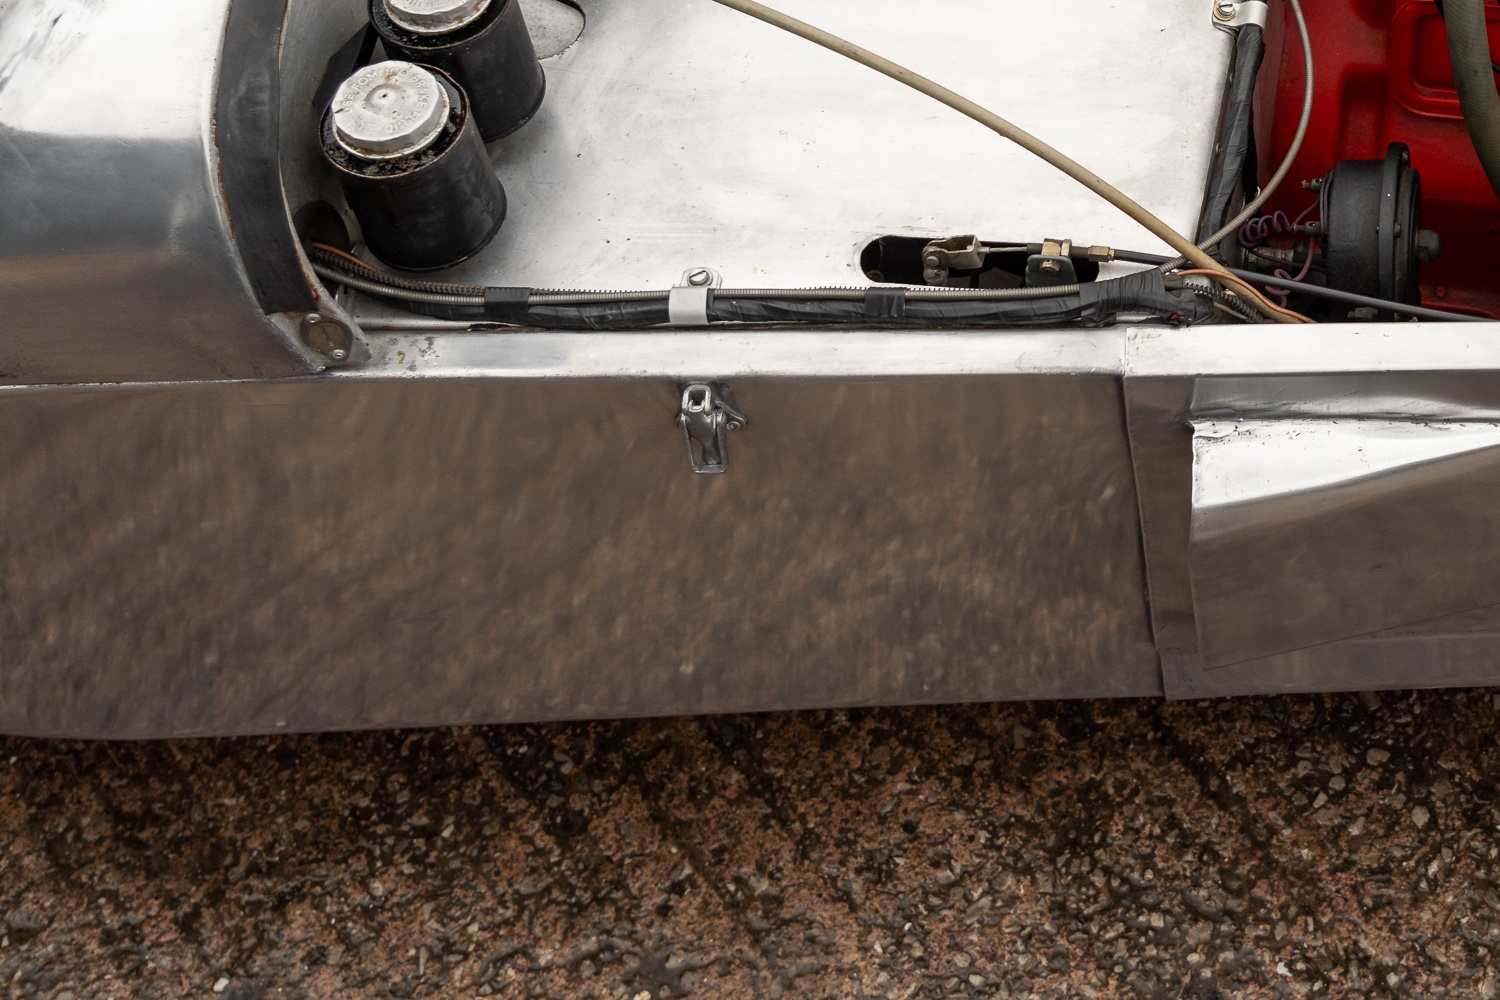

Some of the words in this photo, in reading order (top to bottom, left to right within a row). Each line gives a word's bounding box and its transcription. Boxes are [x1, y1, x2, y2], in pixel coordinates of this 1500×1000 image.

[341, 93, 355, 114] USE
[351, 68, 409, 91] FOMOCO
[412, 75, 429, 109] BRAKE
